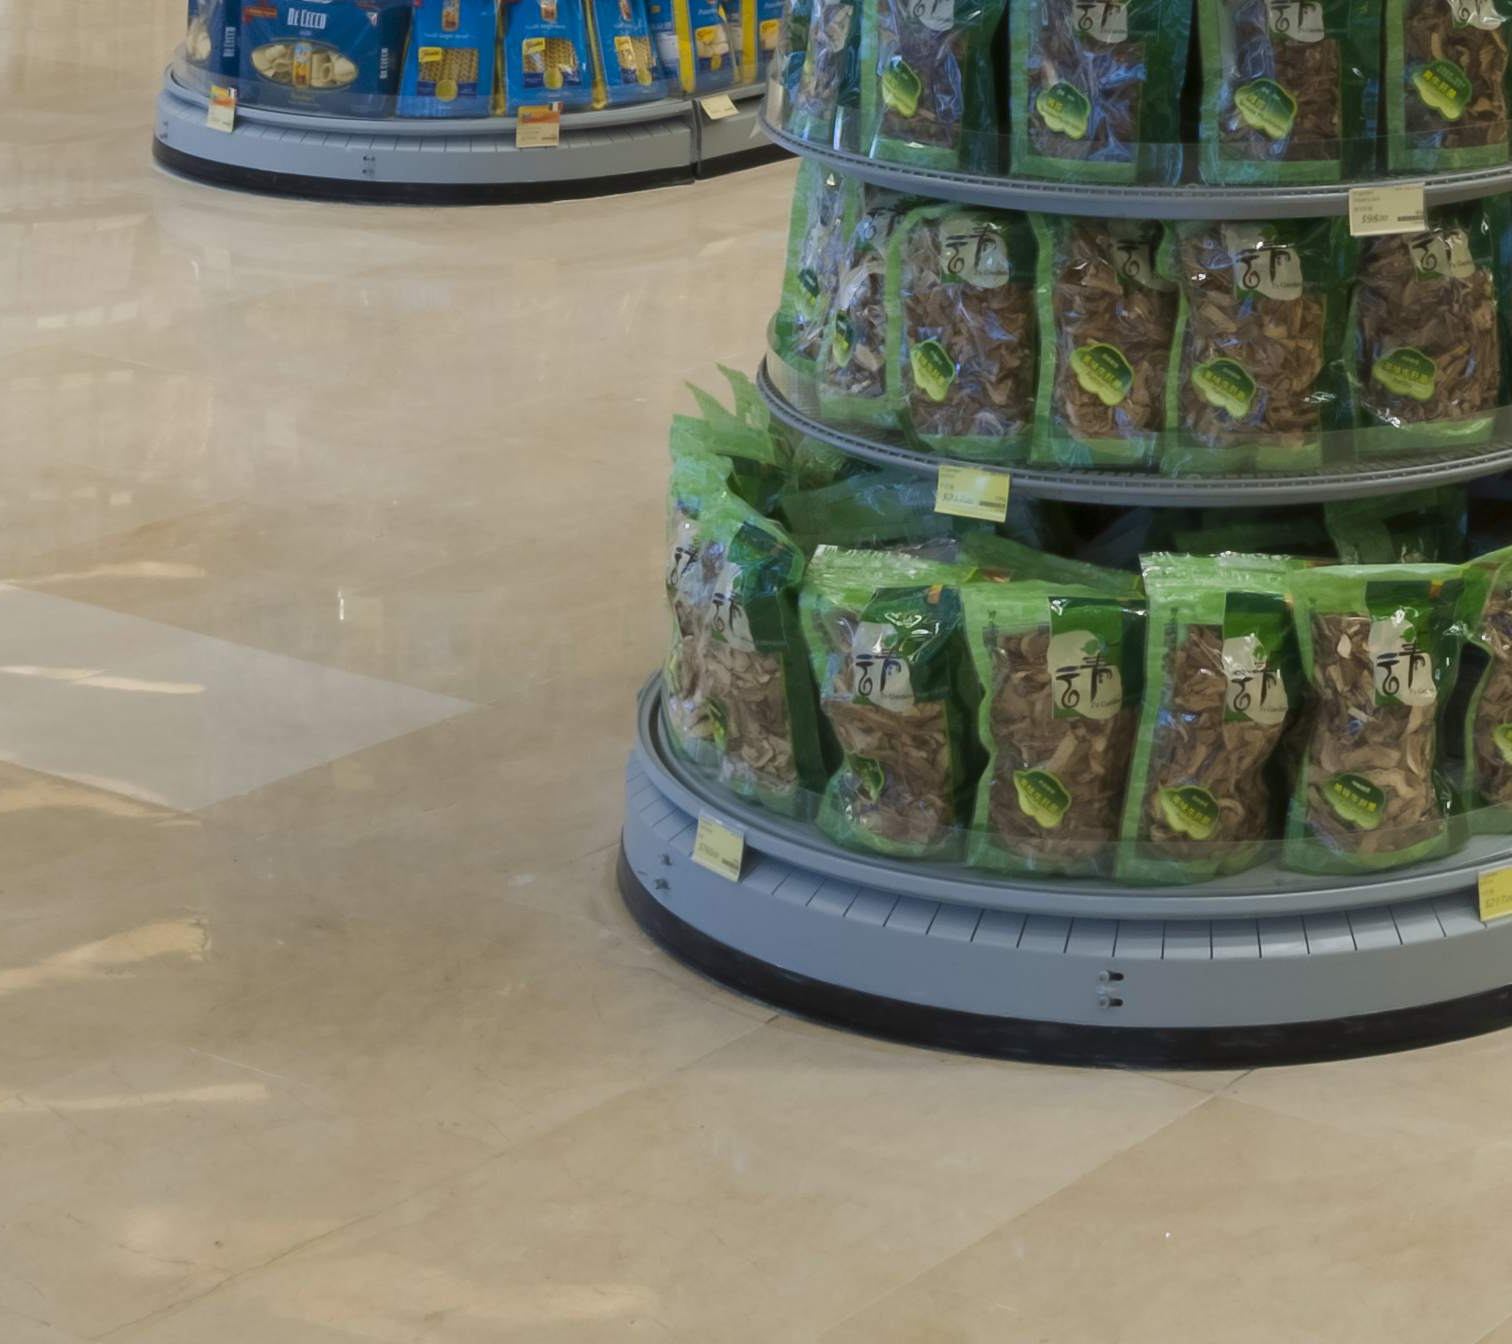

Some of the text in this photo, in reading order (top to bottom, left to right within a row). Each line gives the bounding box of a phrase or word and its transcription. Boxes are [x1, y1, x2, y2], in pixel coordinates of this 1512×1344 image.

[287, 7, 328, 29] DE CECCO
[1361, 213, 1388, 225] $98.00
